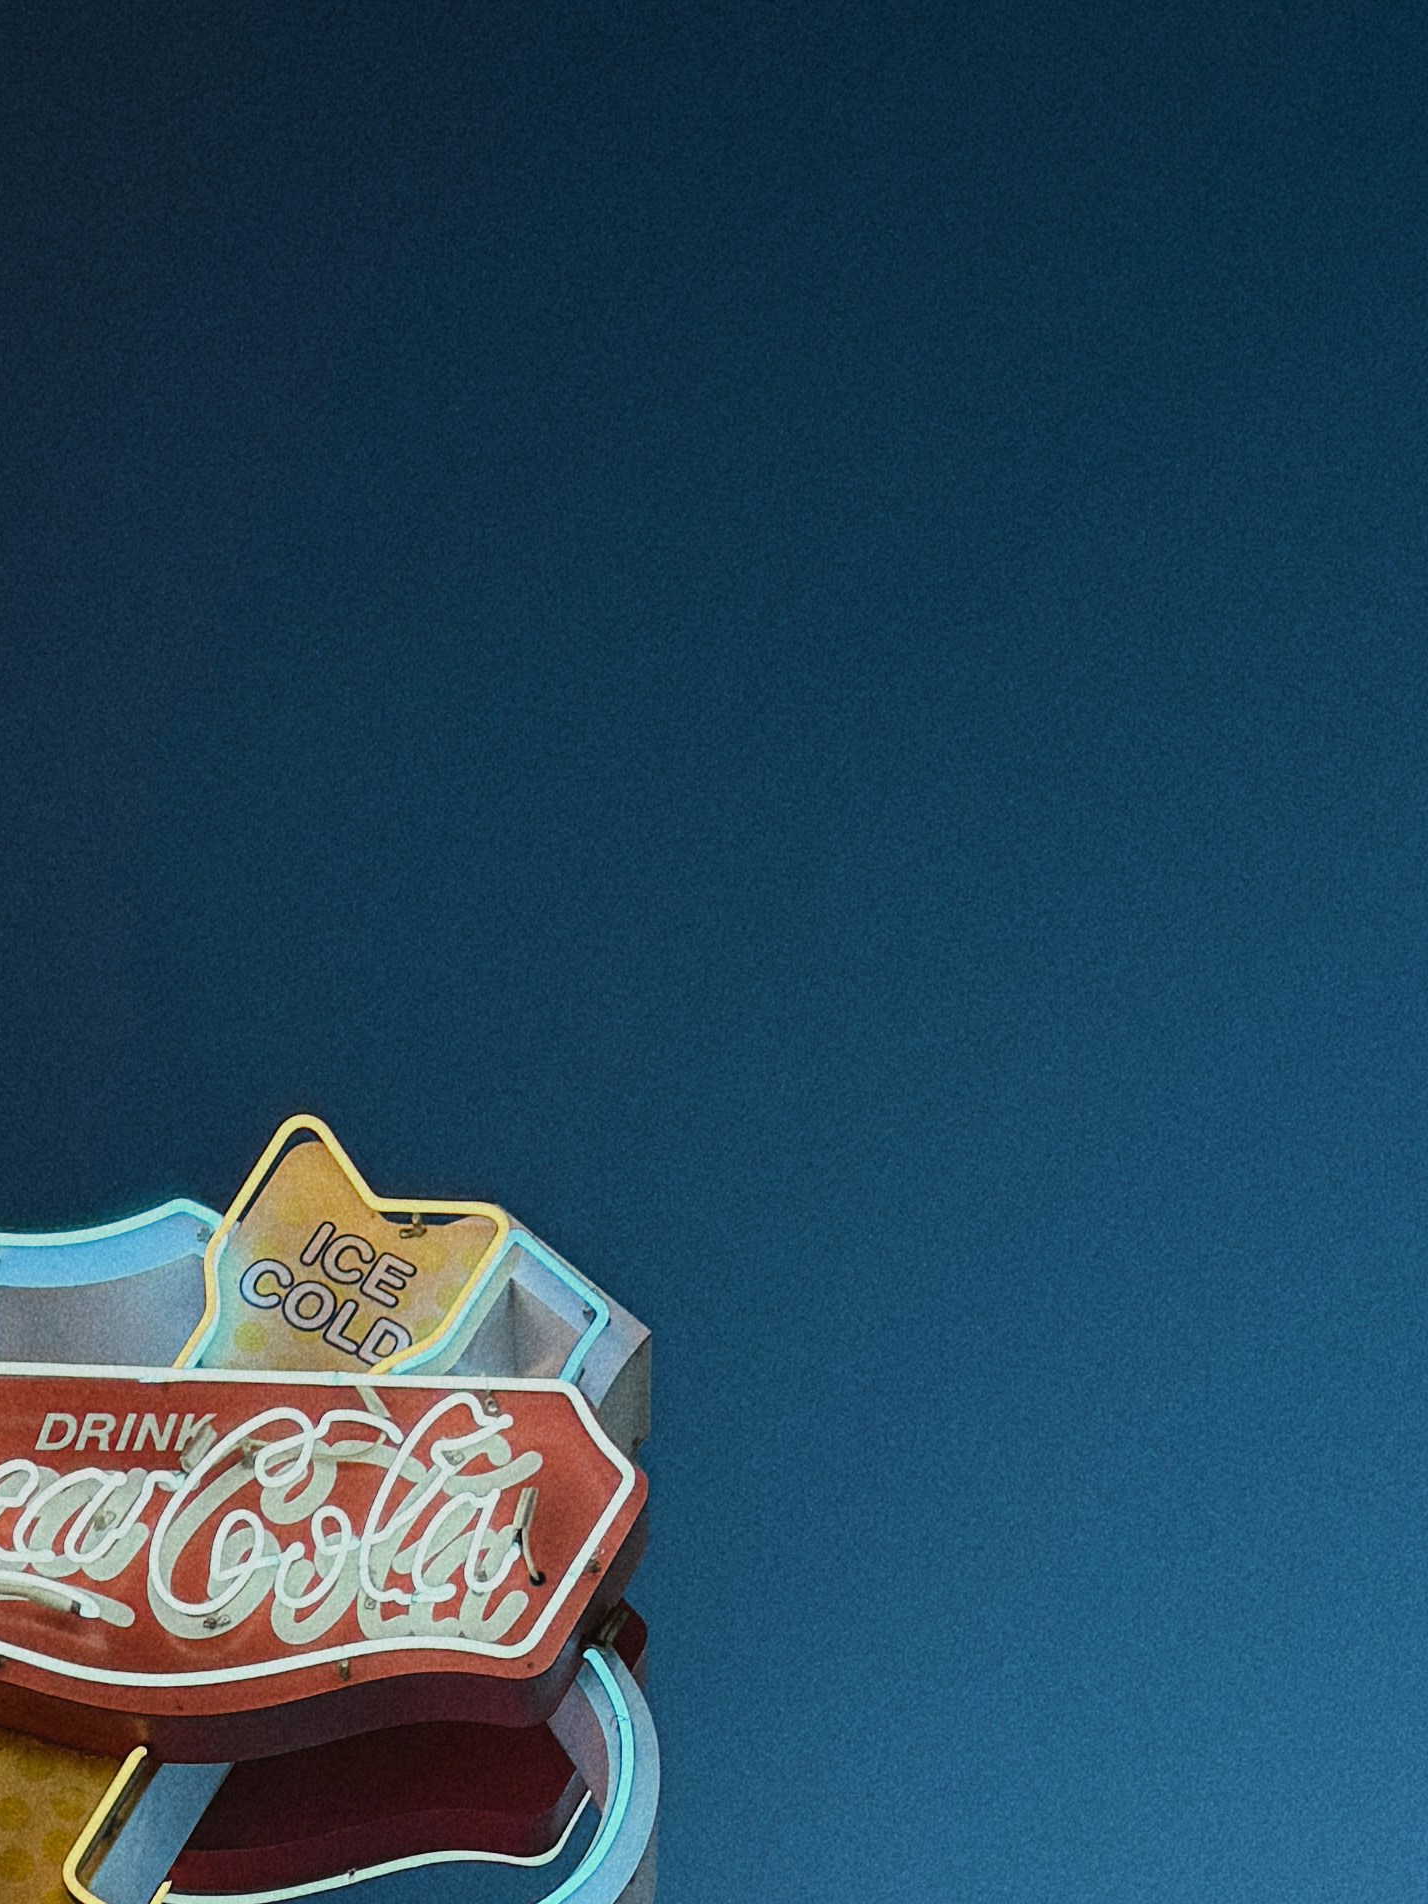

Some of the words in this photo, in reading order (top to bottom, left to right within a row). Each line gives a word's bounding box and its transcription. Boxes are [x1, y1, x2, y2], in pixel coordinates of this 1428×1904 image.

[300, 1219, 414, 1311] ICE
[235, 1256, 414, 1371] COLD
[36, 1410, 220, 1453] DRINK
